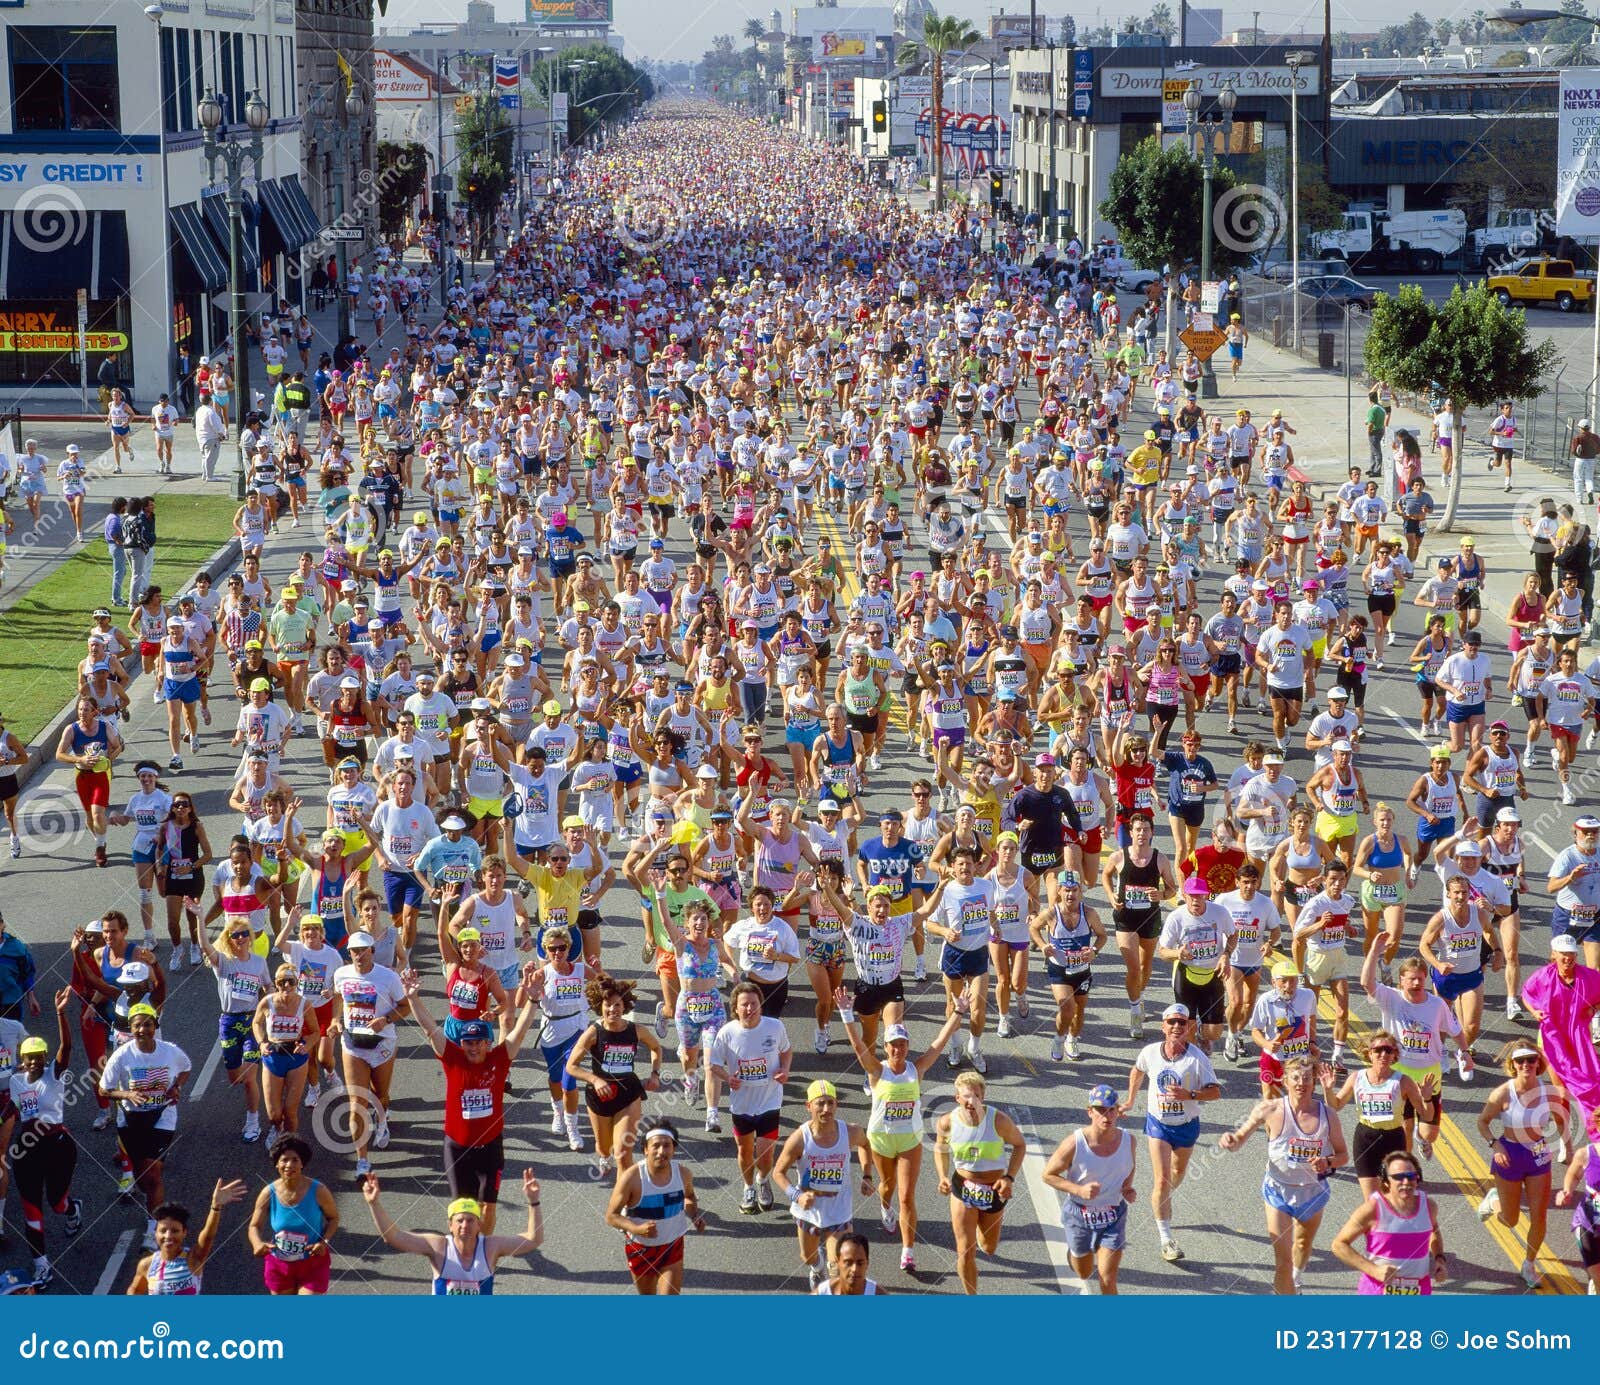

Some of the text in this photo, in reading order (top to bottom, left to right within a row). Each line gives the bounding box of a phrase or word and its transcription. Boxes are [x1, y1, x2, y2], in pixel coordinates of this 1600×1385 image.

[374, 59, 392, 68] MW
[376, 70, 401, 78] SCHE
[1564, 89, 1593, 100] KNX
[1564, 101, 1600, 110] NEWSR
[1572, 117, 1600, 126] OFFIC
[0, 165, 27, 182] SY
[43, 164, 127, 182] CREDIT
[0, 312, 73, 332] ARRY...
[865, 658, 891, 670] ATMAN
[869, 857, 910, 875] BYU
[964, 908, 987, 919] 8765
[1283, 1042, 1309, 1054] 9425
[1403, 1037, 1430, 1048] 8014
[462, 1094, 491, 1107] 15617
[1361, 1100, 1392, 1112] F1539
[811, 1168, 842, 1180] 9626
[962, 1188, 993, 1203] 9328
[167, 1279, 193, 1290] SPORT
